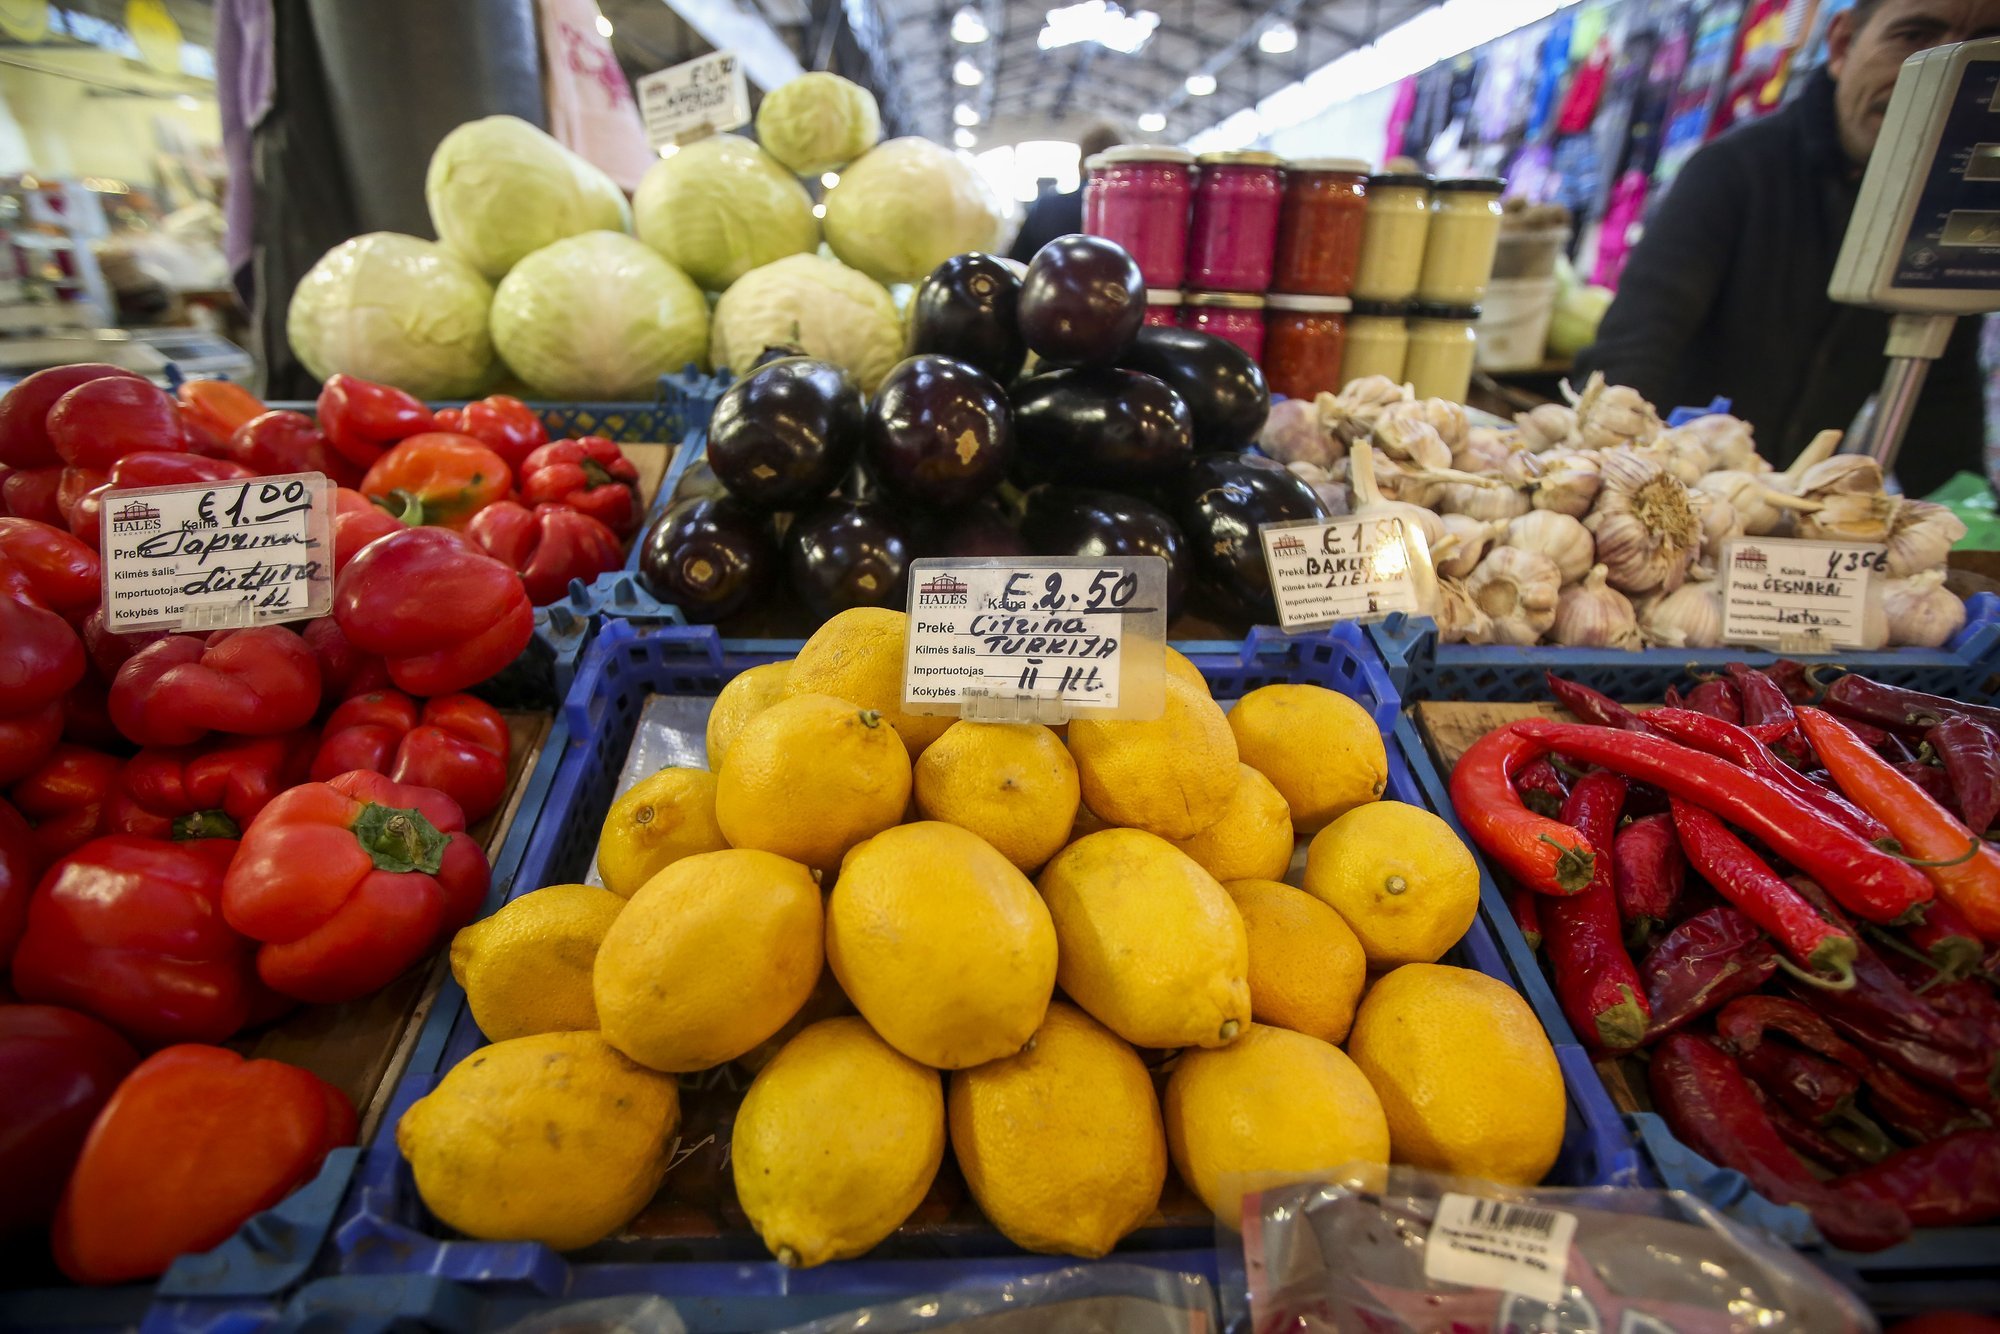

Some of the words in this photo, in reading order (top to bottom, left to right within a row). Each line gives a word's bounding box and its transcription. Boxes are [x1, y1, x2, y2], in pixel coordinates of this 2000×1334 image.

[181, 518, 218, 533] Kaina
[114, 569, 149, 580] Kilmės
[151, 567, 175, 577] šalis
[115, 585, 185, 600] Importuotojas
[988, 597, 1026, 610] Kaina
[115, 607, 159, 619] Kokybės
[165, 605, 184, 615] klas
[917, 621, 955, 633] Prekė
[915, 645, 949, 655] Kilmės
[952, 645, 976, 655] šalis
[913, 665, 984, 678] Importuotojas
[912, 686, 956, 698] Kokybės
